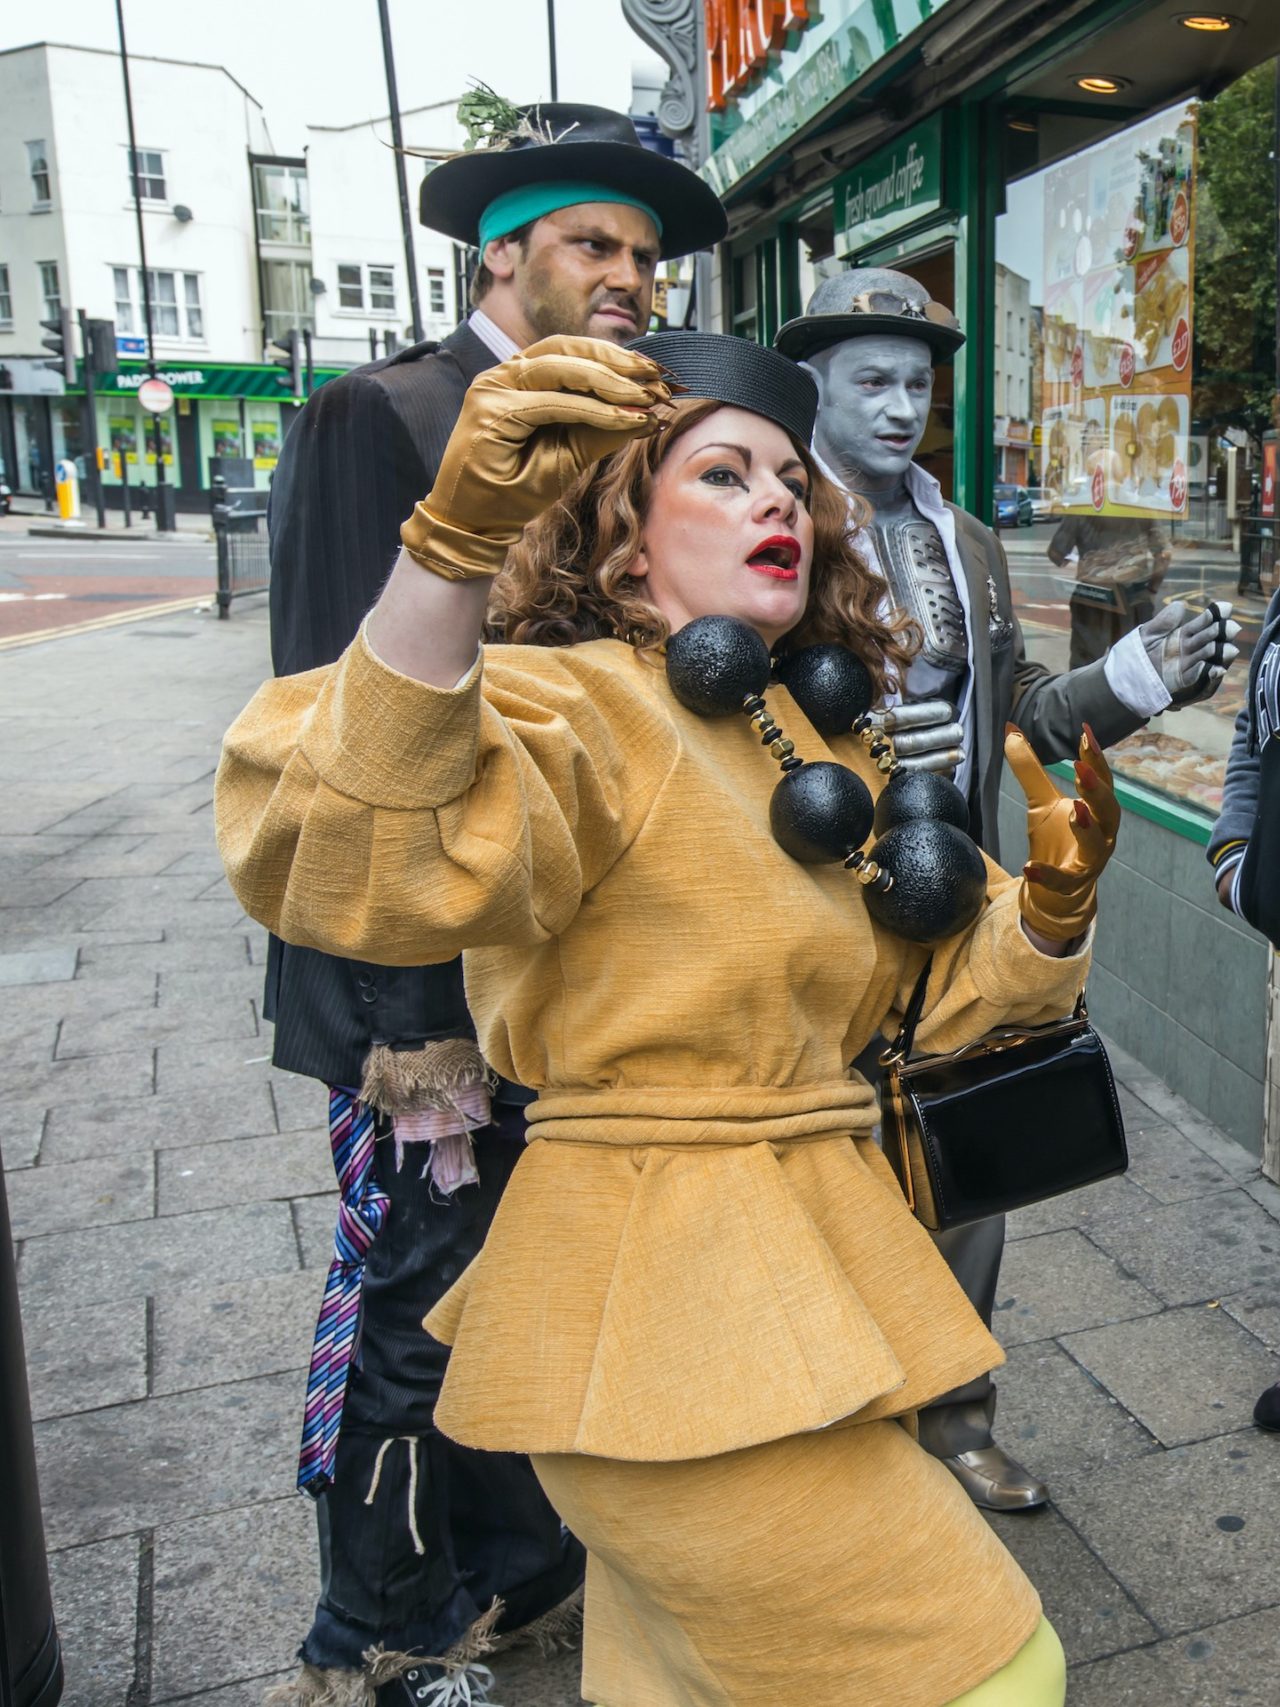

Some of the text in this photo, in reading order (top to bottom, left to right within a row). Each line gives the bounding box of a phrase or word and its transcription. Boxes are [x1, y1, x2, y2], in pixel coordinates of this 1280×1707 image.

[845, 141, 924, 232] fresh ground coffee
